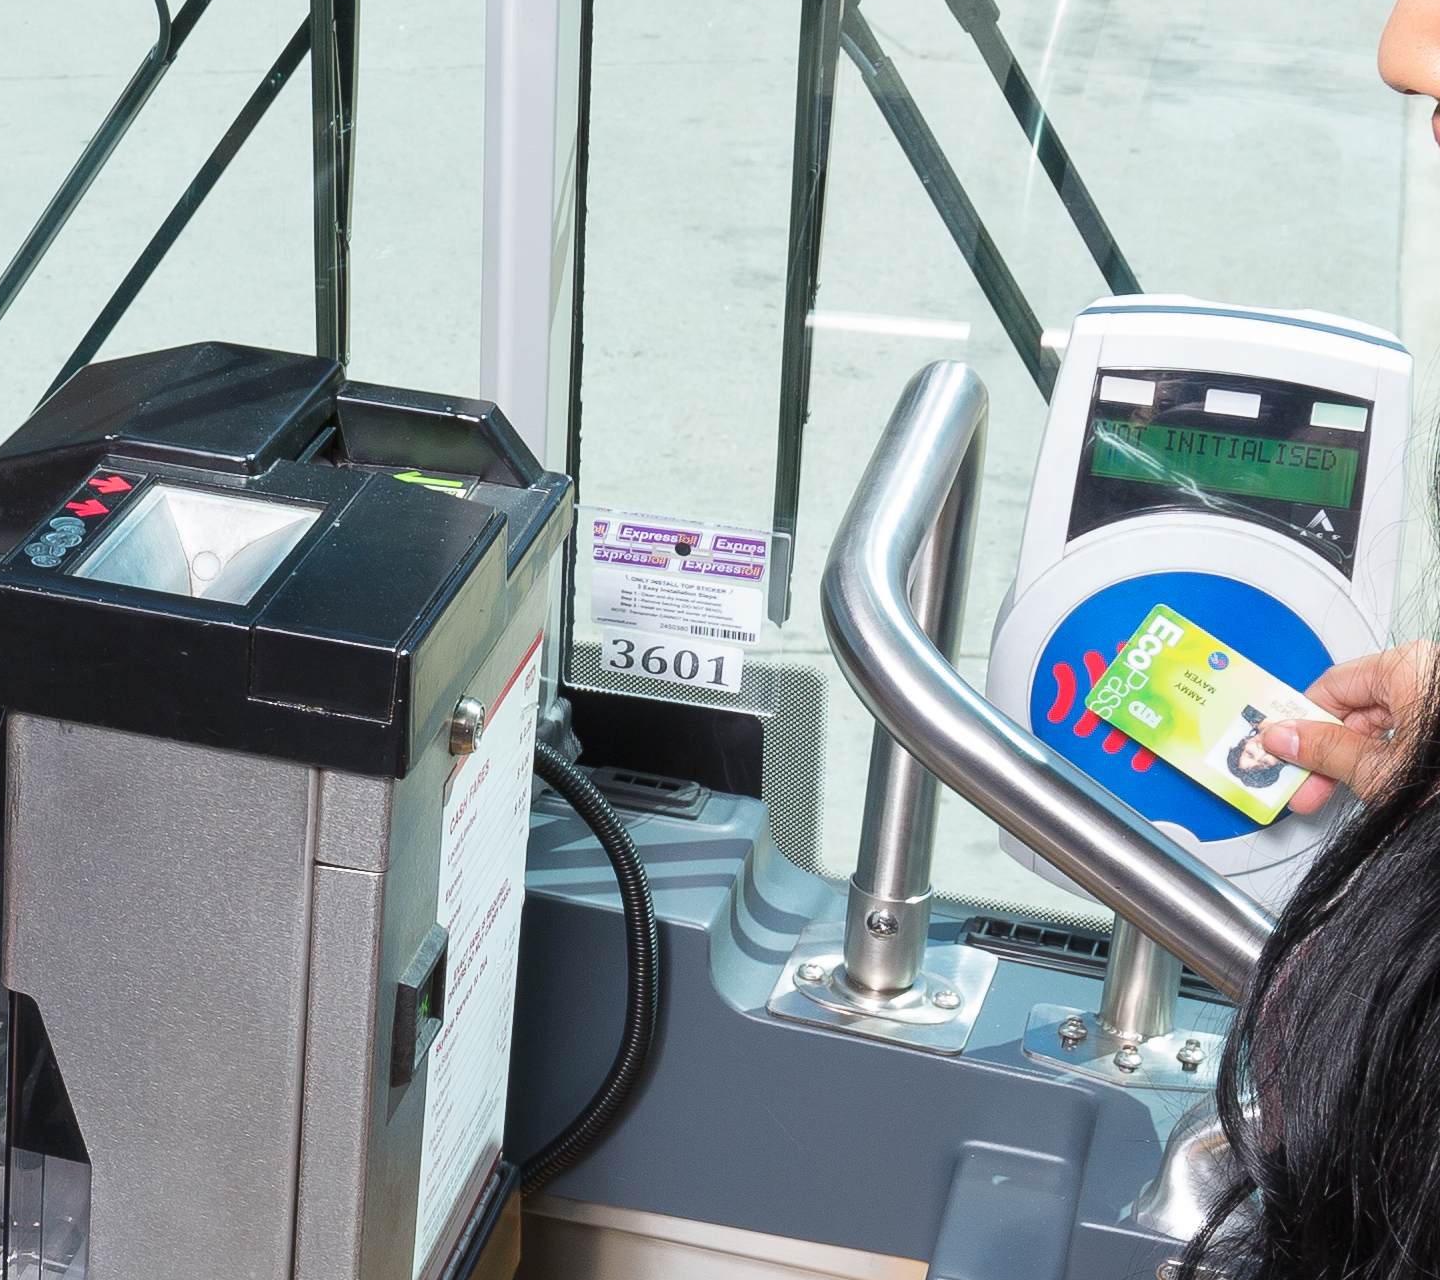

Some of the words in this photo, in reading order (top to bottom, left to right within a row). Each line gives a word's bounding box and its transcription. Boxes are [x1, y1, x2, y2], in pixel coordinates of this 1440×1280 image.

[1164, 429, 1338, 471] INITIALISED
[621, 527, 698, 547] ExpressToll
[593, 547, 667, 567] ExpressToll
[684, 560, 760, 578] ExpressToll
[630, 576, 650, 585] ONLY
[650, 579, 680, 588] INSTALL
[696, 584, 727, 595] STICKER
[642, 585, 659, 593] Easy
[660, 587, 697, 597] Installation
[609, 638, 730, 687] 3601
[1088, 614, 1185, 721] EcoPass
[1173, 681, 1209, 707] TAMMY
[1183, 669, 1218, 696] MAYER
[1127, 700, 1164, 730] RTD
[449, 792, 468, 838] CASH
[468, 755, 489, 805] FARES
